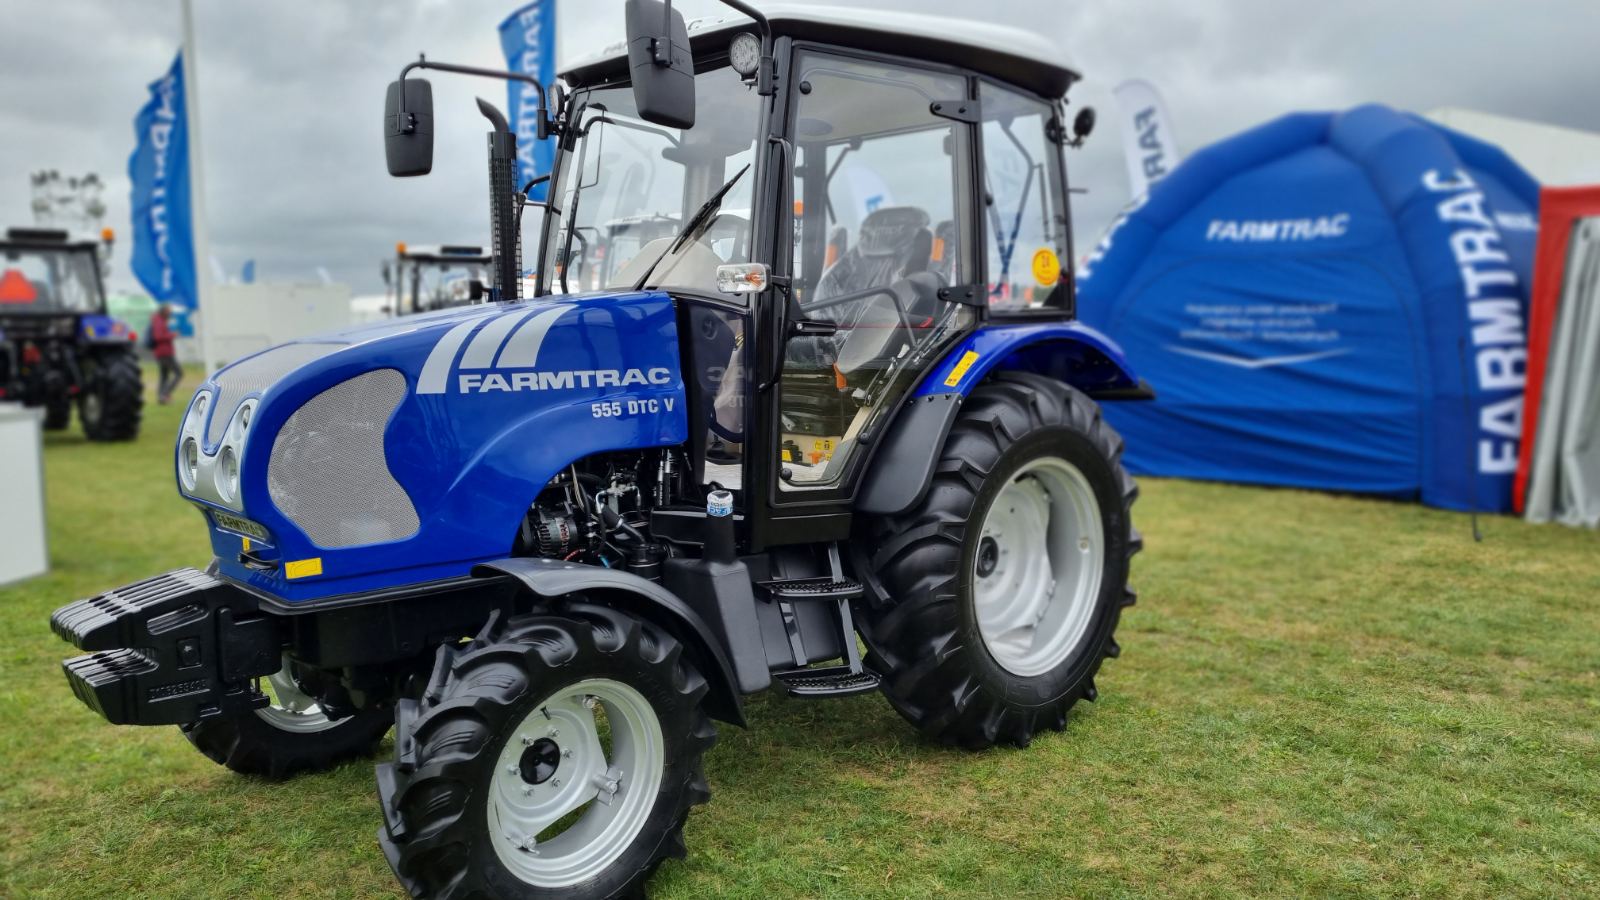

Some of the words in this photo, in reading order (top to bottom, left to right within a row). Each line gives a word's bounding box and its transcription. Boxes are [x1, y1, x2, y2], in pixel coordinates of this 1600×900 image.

[1206, 213, 1350, 241] FARMTRAC
[1422, 168, 1528, 474] FARMTRAC
[458, 367, 671, 394] FARMTRAC
[591, 402, 622, 418] 555
[628, 400, 658, 415] DTC
[664, 398, 674, 412] V
